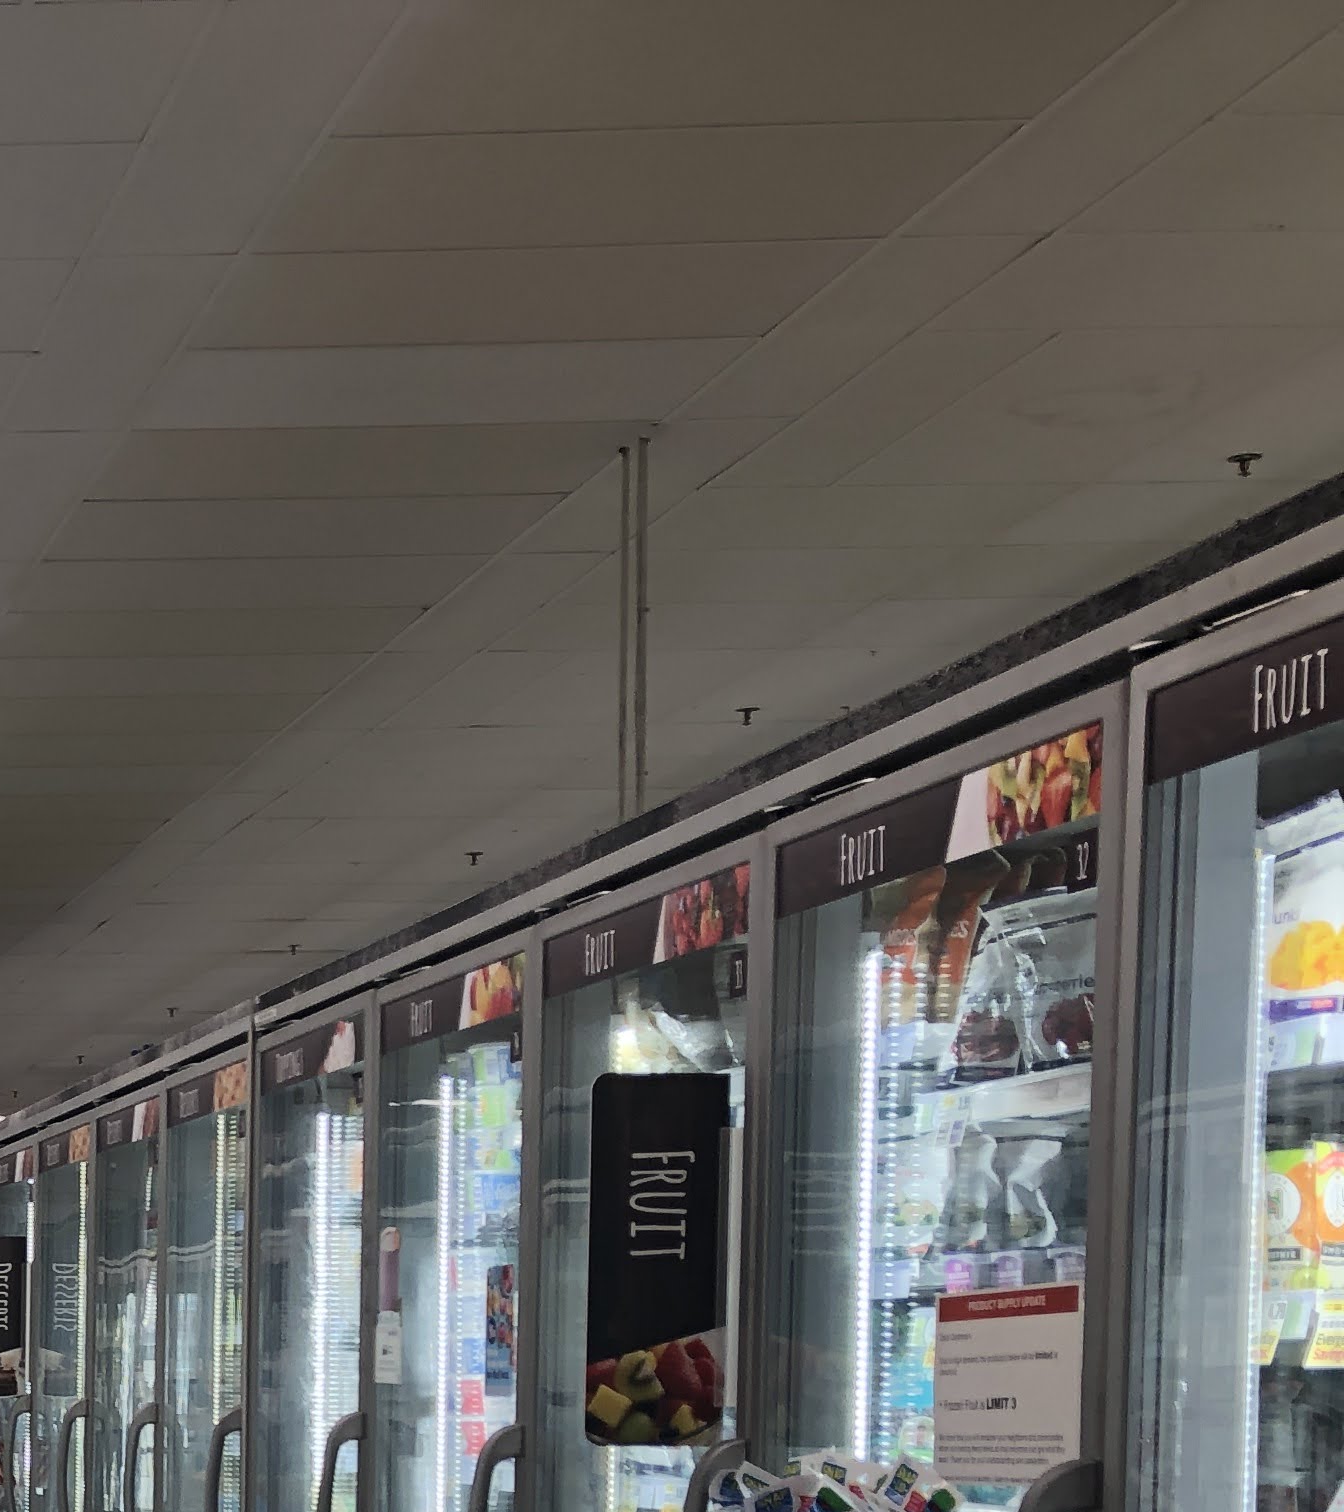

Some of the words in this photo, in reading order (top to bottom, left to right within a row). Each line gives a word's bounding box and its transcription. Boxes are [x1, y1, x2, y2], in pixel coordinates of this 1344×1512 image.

[1253, 647, 1328, 733] FRUIT
[840, 825, 886, 886] FRUIT
[584, 929, 616, 976] FRUIT
[628, 1150, 695, 1262] FRUIT
[986, 1398, 1010, 1410] LIMIT
[1011, 1397, 1017, 1410] 3
